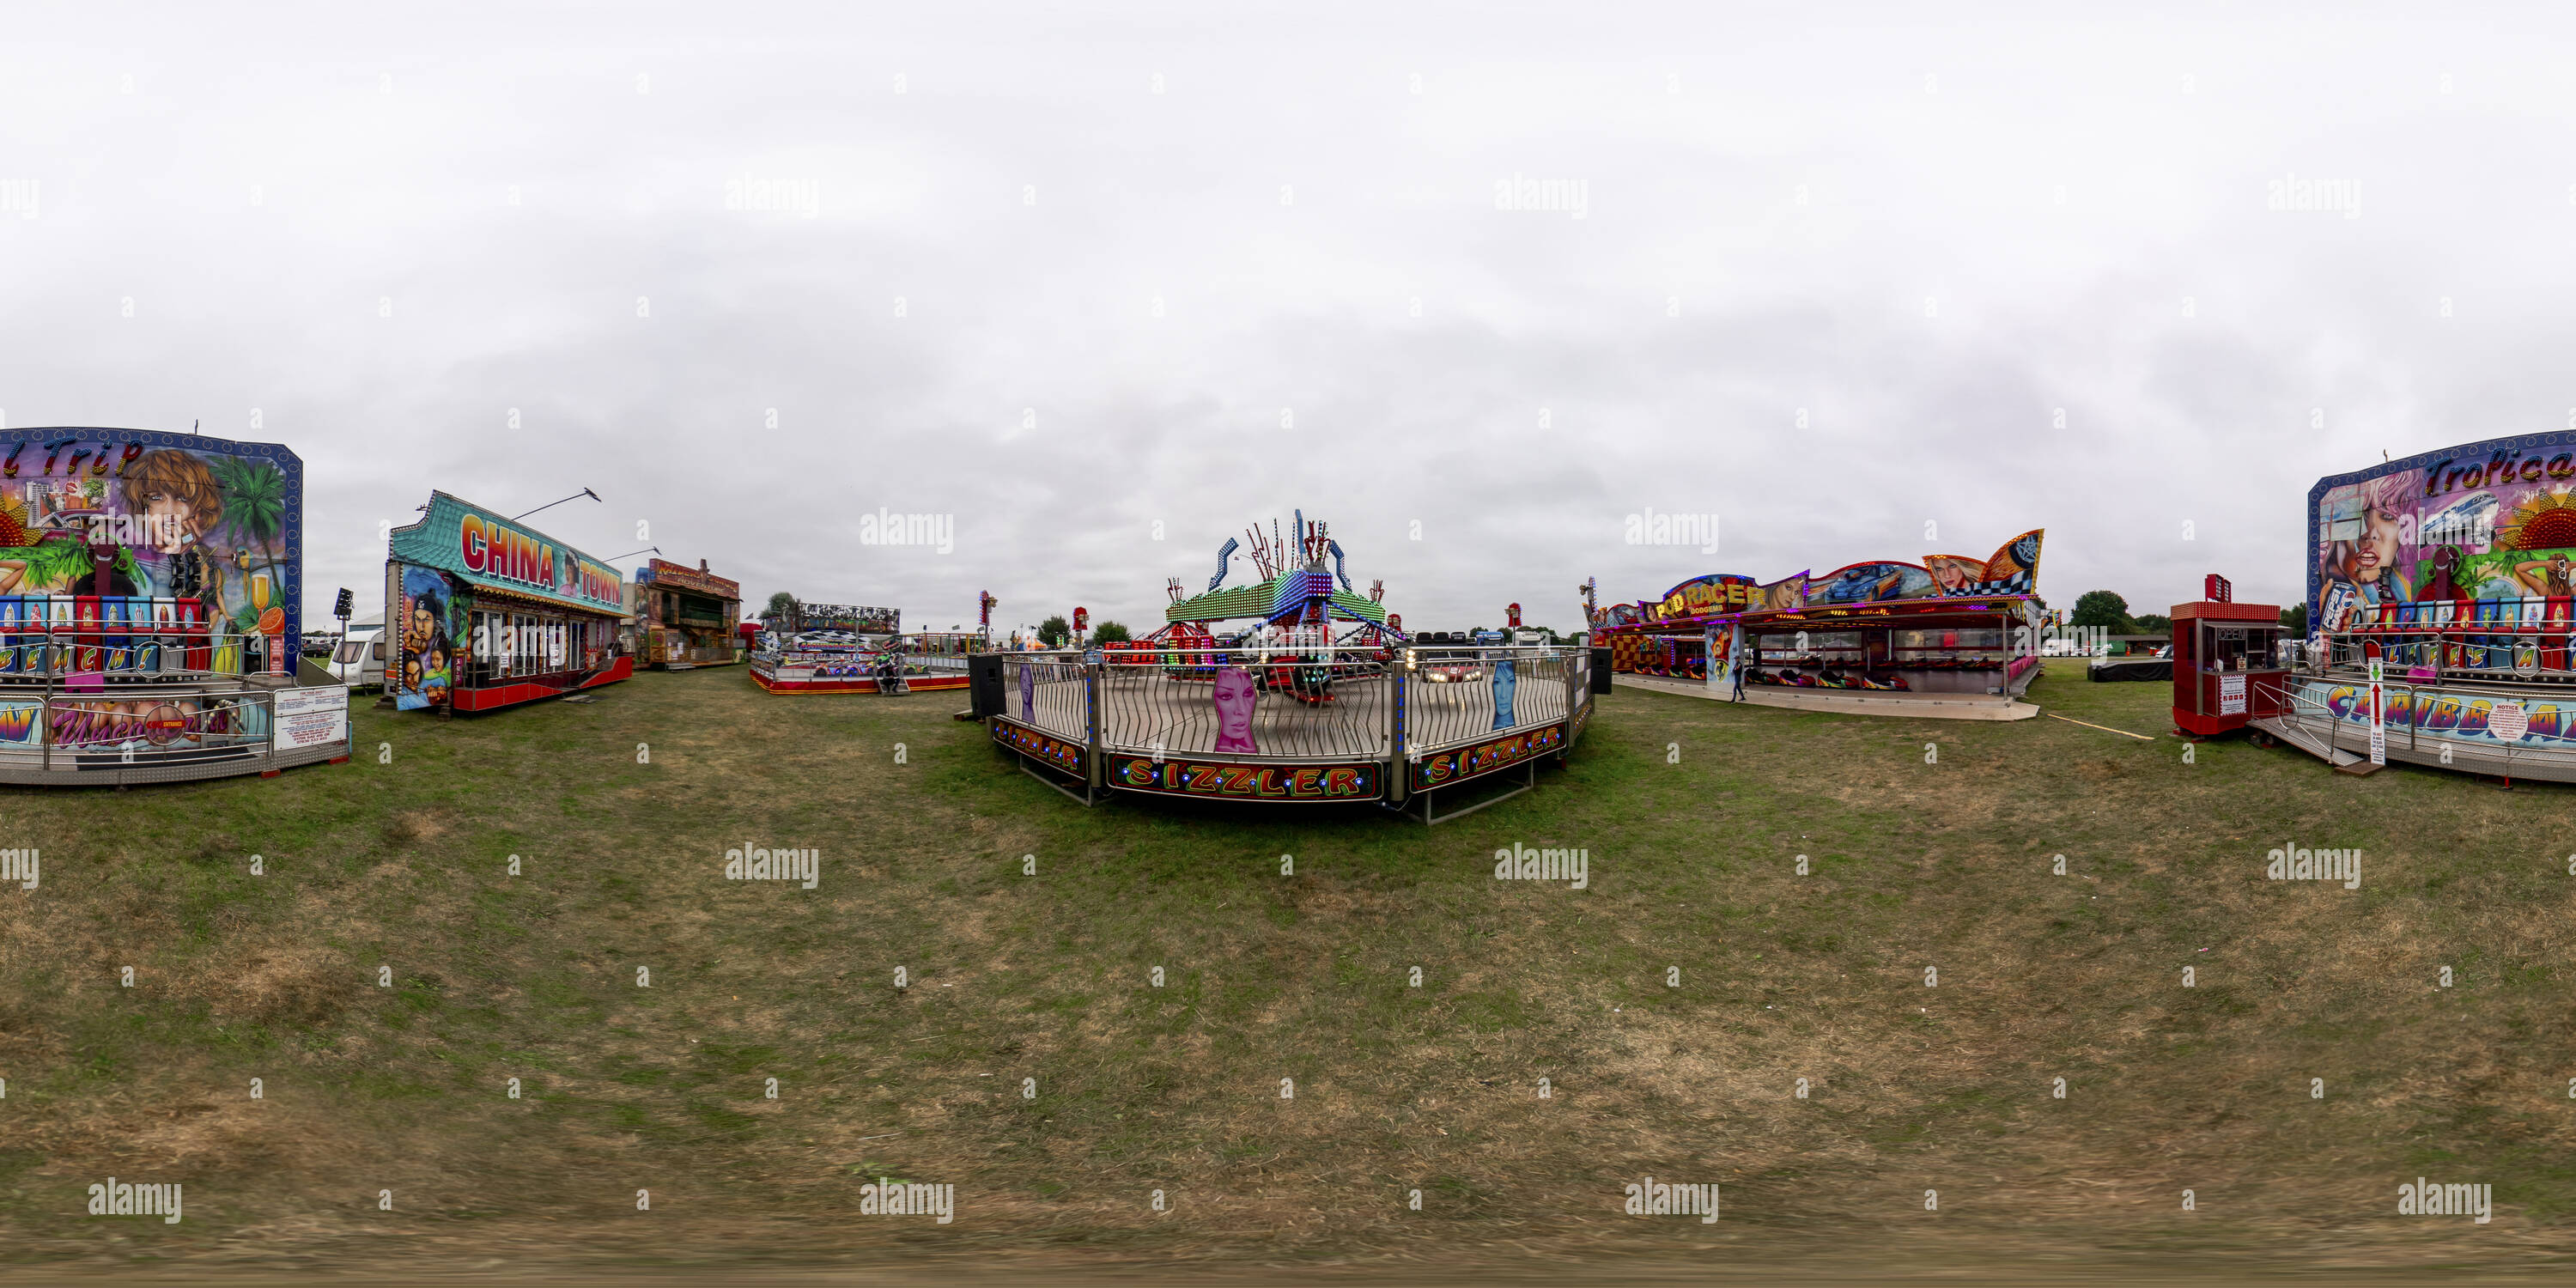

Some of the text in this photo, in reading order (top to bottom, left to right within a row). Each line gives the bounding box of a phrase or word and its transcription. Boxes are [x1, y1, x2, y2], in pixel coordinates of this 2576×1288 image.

[44, 435, 144, 476] Trip
[2425, 447, 2576, 496] Tropica
[459, 513, 623, 608] CHINA TOWN
[1656, 583, 1766, 618] POD RACER
[1691, 605, 1723, 615] DODGEMS
[2323, 587, 2342, 629] PEPSI
[2219, 629, 2245, 640] OPEN
[2517, 647, 2536, 669] A
[998, 722, 1078, 771] SIZZLER
[1427, 726, 1561, 784] SIZZLER
[1126, 759, 1365, 798] SIZZLER
